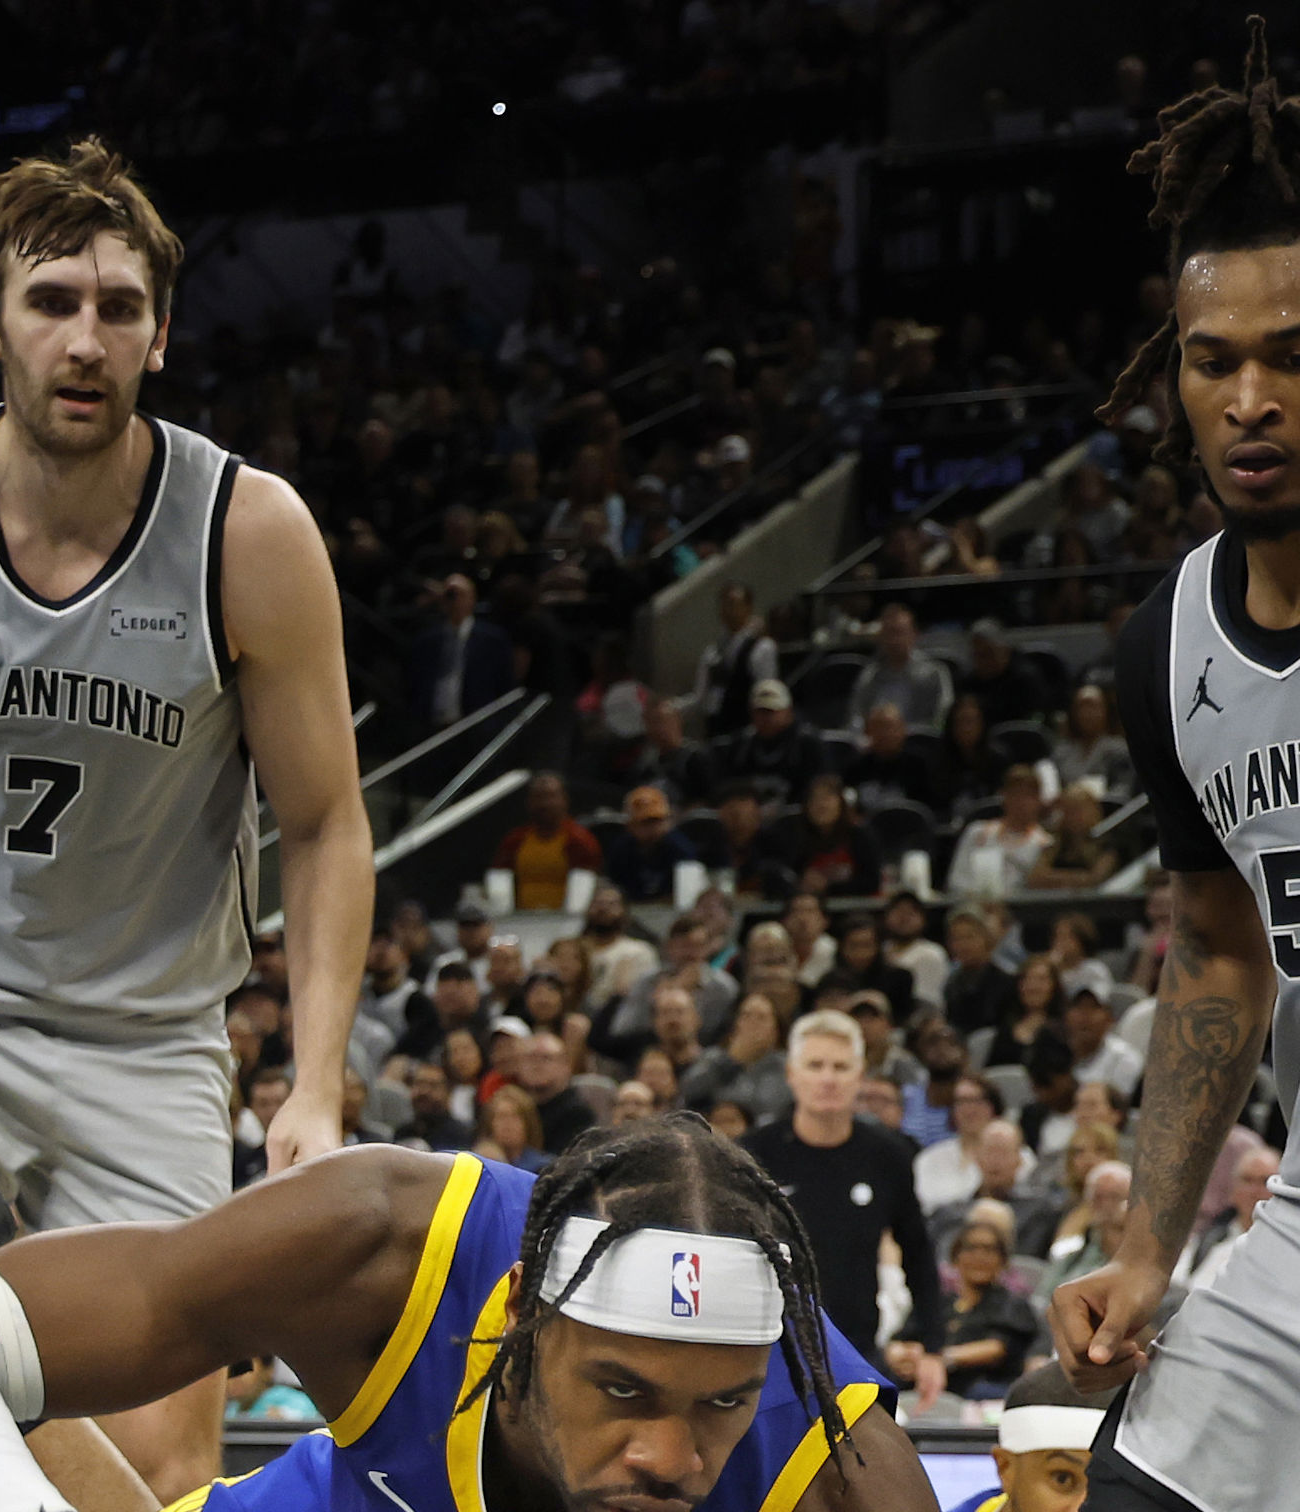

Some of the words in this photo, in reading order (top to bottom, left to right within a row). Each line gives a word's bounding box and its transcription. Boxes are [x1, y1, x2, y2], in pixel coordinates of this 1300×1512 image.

[119, 617, 178, 632] LEDGER
[0, 666, 186, 749] ANTONIO
[3, 754, 85, 860] 7
[1201, 760, 1240, 842] AN
